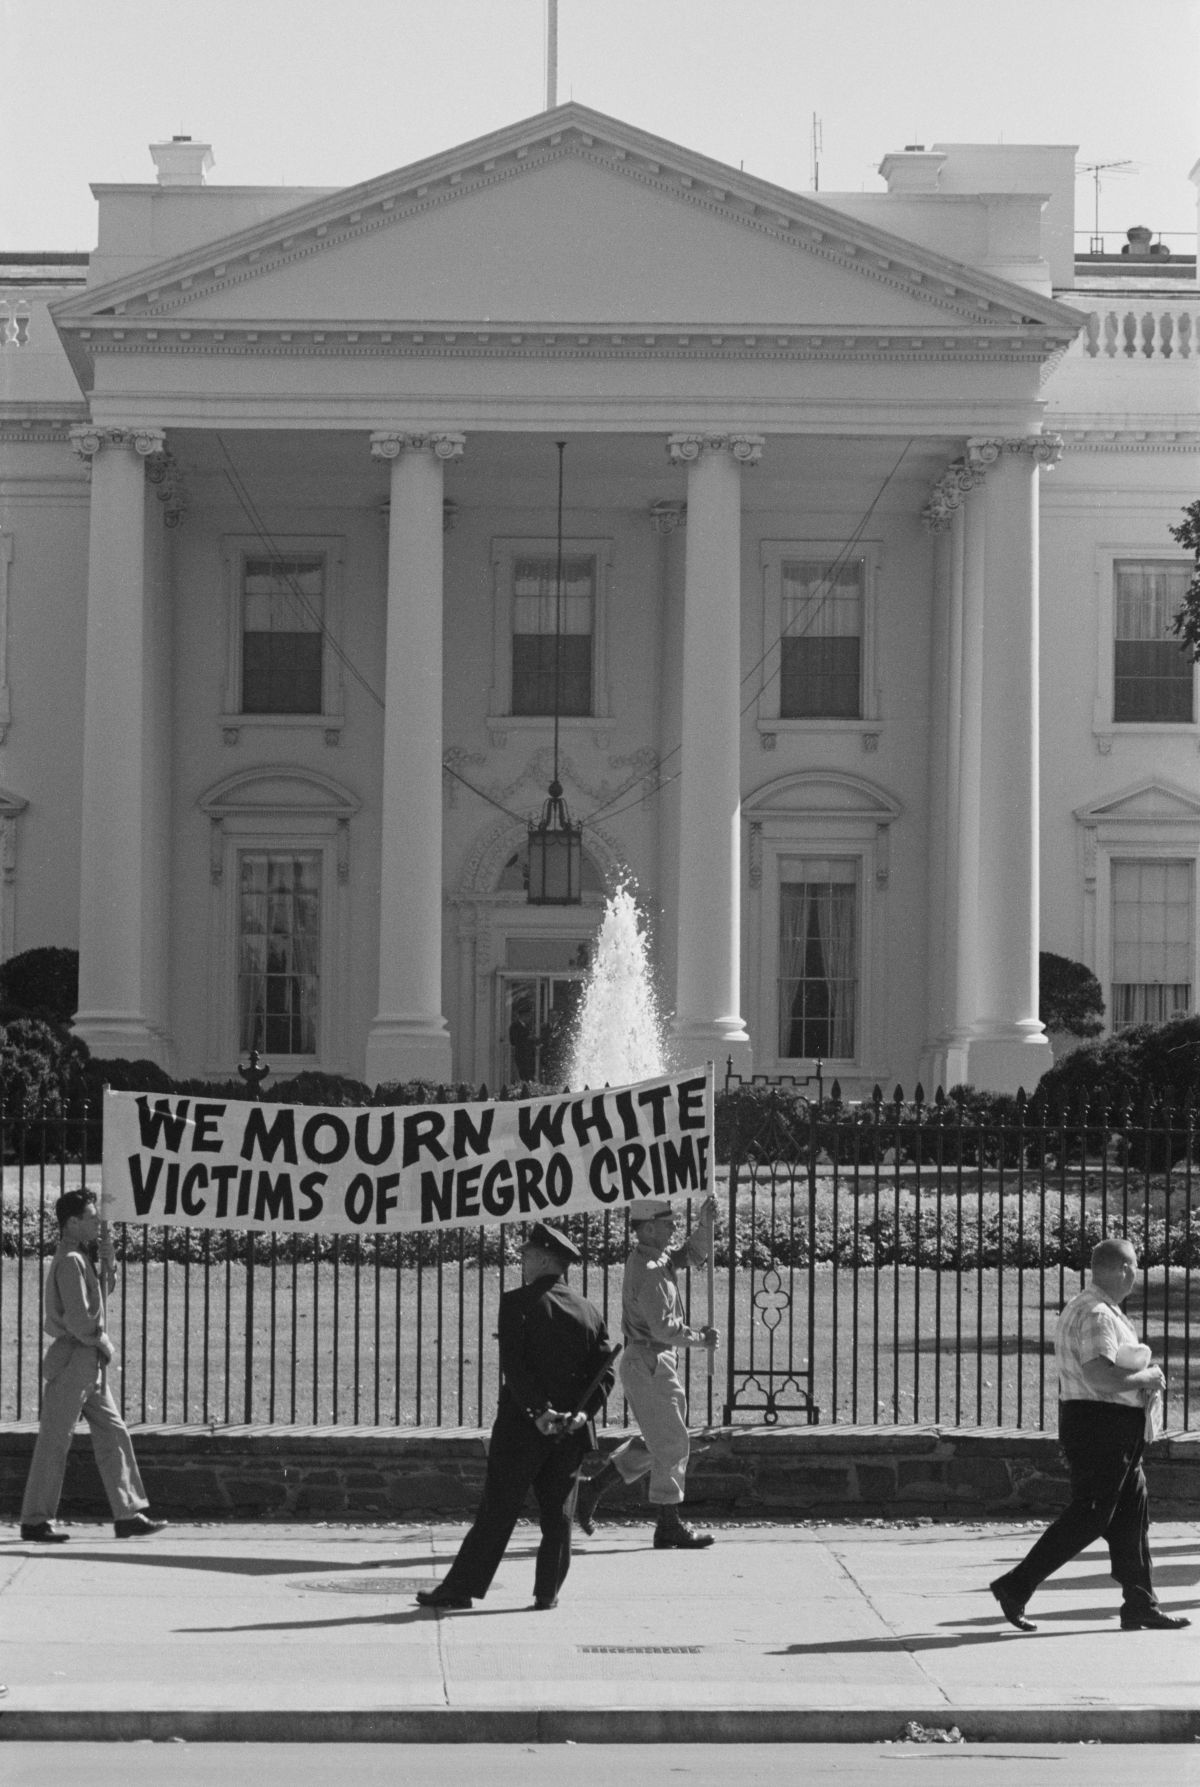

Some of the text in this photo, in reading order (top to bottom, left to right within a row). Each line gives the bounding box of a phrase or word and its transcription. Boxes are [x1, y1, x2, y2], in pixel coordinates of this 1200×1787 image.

[135, 1076, 707, 1168] WE MOURN WHITE
[128, 1134, 710, 1225] VICTIMS OF NEGRO CRIME
